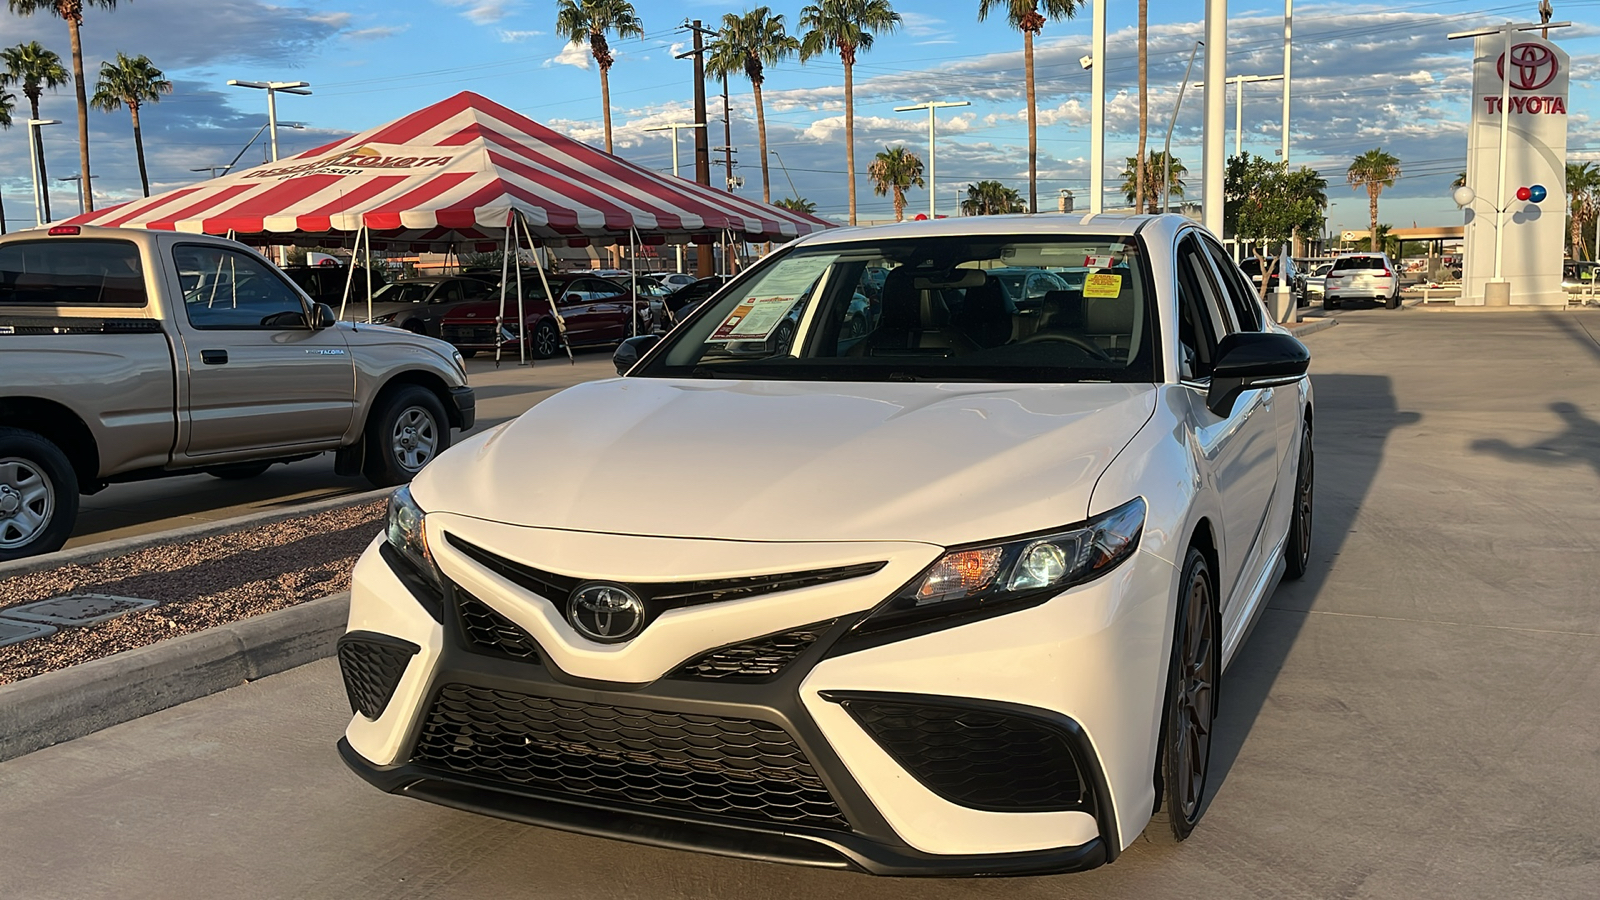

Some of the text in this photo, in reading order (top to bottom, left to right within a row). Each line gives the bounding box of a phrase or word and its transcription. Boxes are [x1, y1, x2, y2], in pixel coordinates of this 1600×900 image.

[1484, 96, 1566, 114] TOYOTA
[241, 154, 453, 179] DESERT TOYOTA
